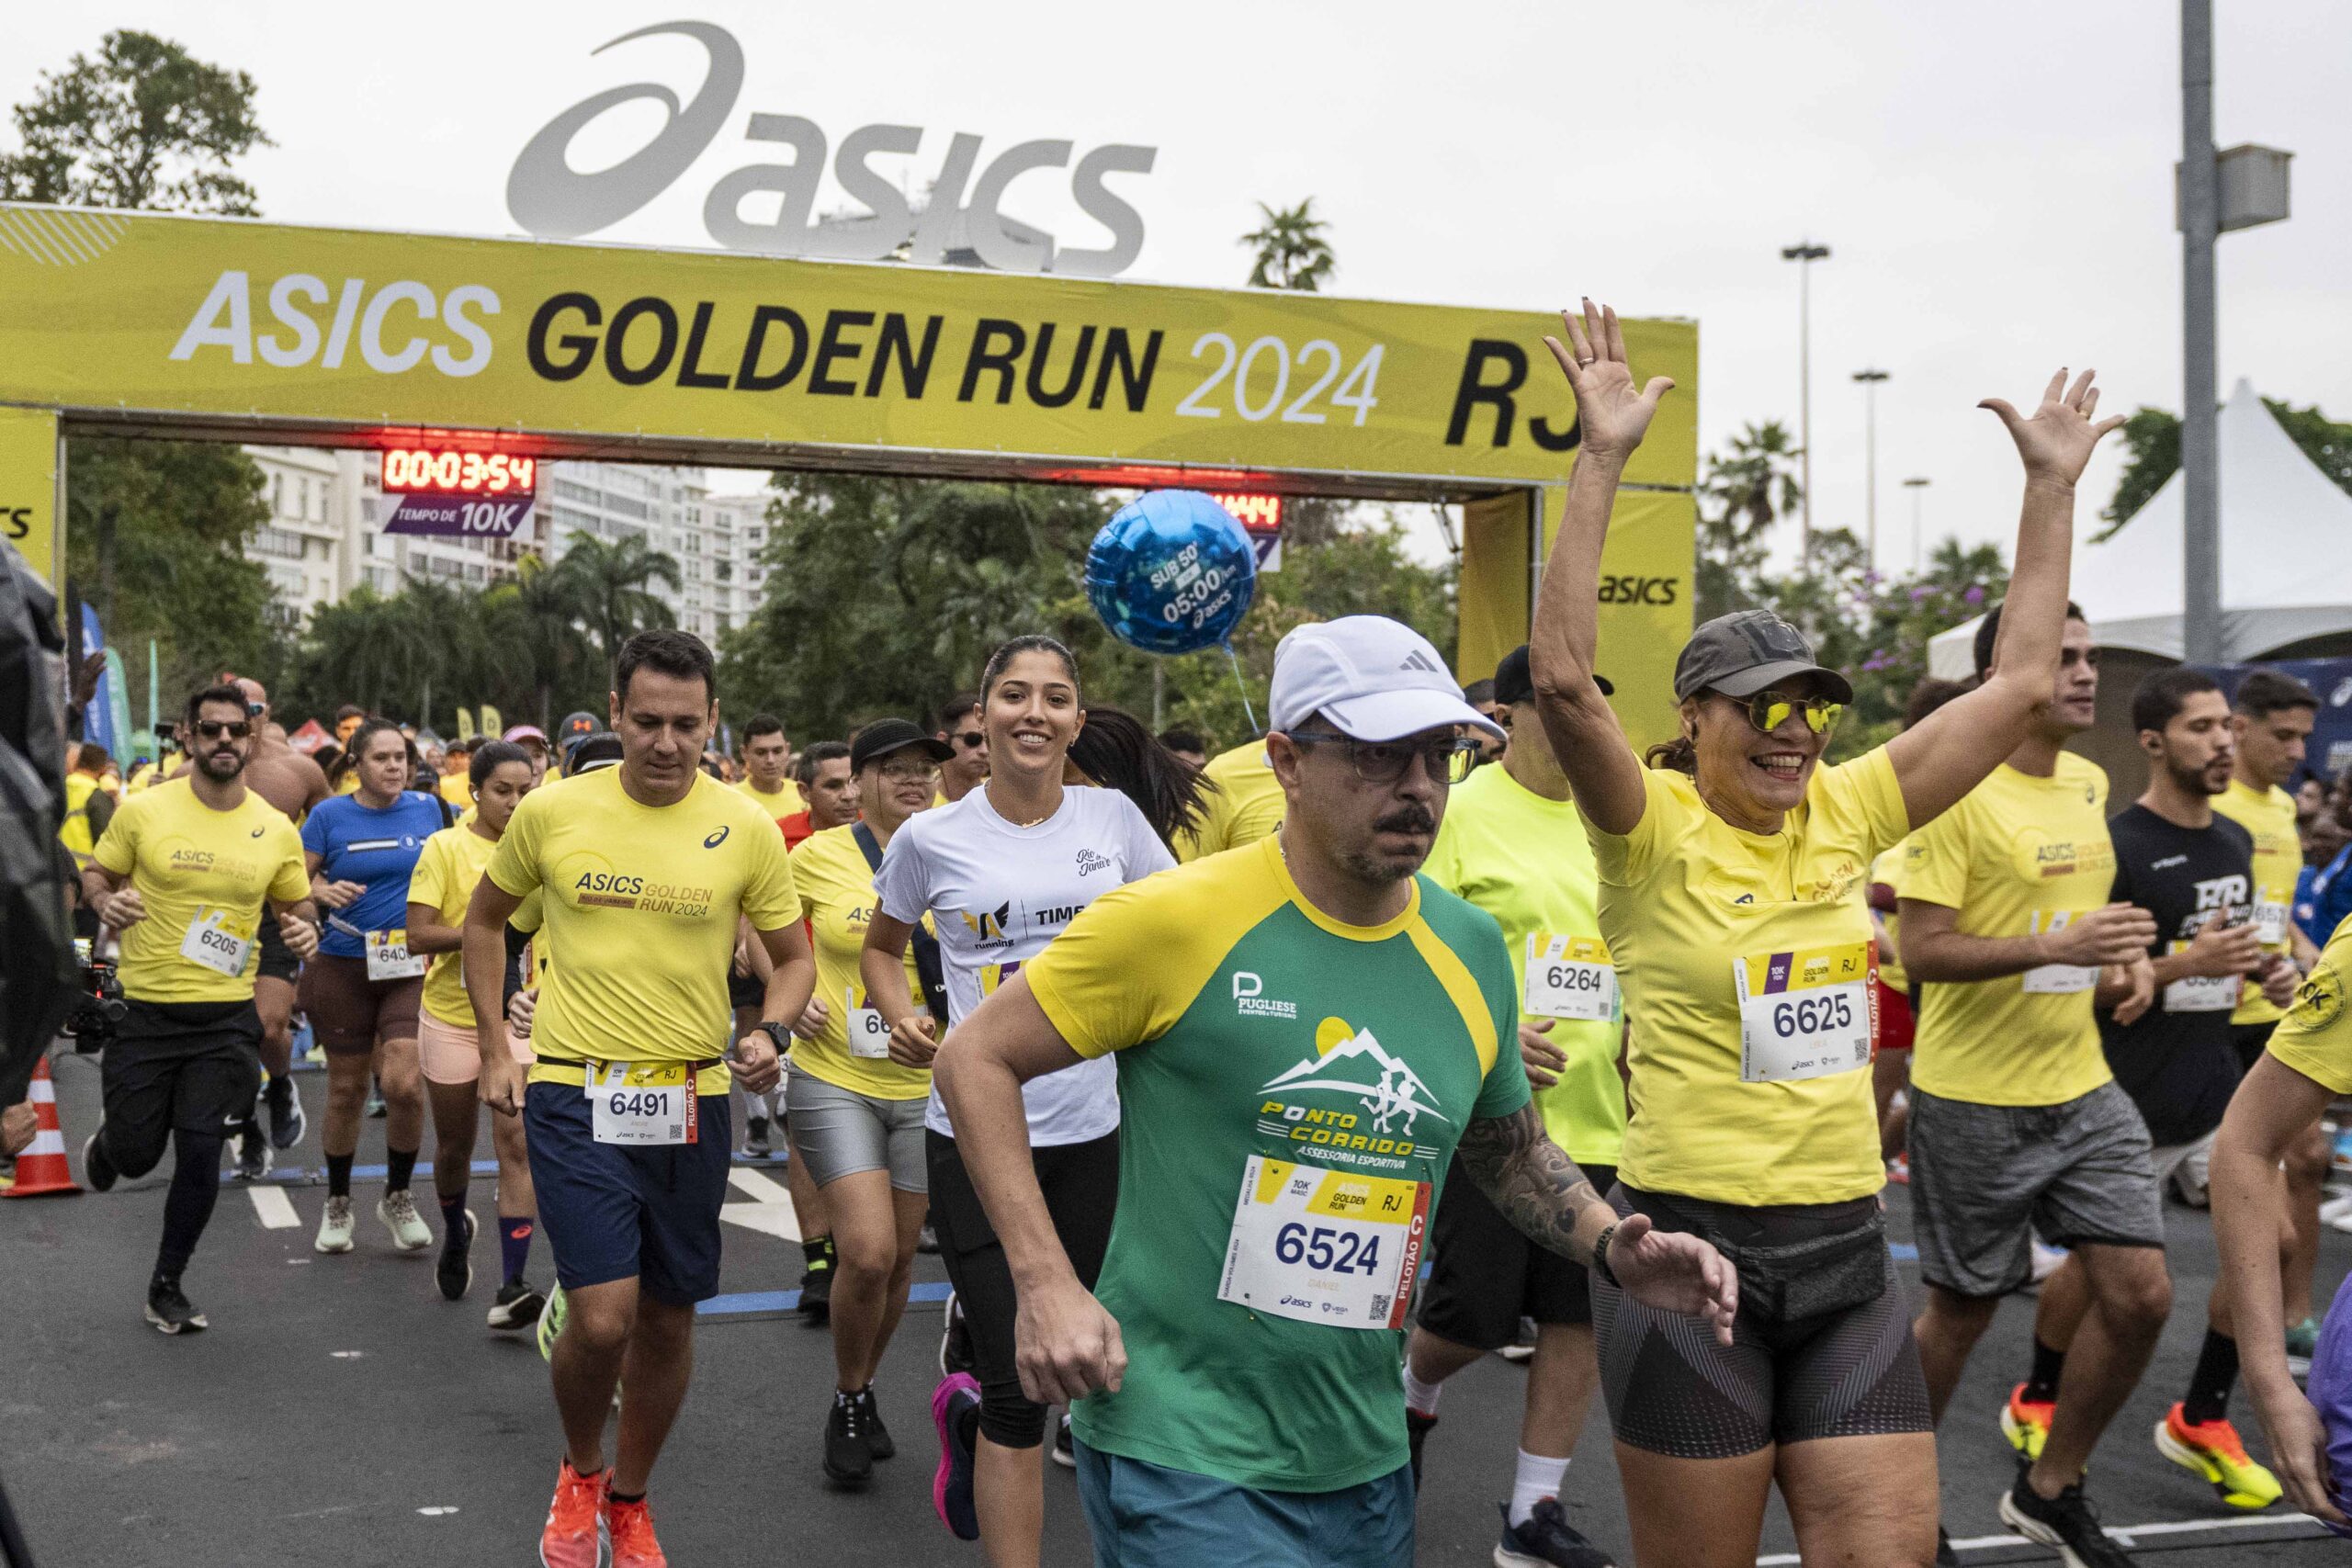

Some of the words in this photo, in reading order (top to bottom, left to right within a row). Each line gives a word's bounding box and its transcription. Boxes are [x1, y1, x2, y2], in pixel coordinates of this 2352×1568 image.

[704, 111, 1158, 276] asics
[169, 270, 503, 378] ASICS
[527, 291, 944, 400] GOLDEN
[957, 318, 1164, 412] RUN
[1176, 332, 1385, 427] 2024
[385, 448, 534, 491] 00:03:54
[398, 507, 438, 522] TEMPO
[440, 509, 458, 523] DE
[461, 502, 520, 533] 10K
[1150, 559, 1180, 590] SUB
[1598, 574, 1679, 605] asics
[170, 850, 214, 864] ASICS
[1076, 848, 1096, 863] Rio
[2037, 842, 2076, 863] ASICS
[575, 872, 644, 895] ASICS
[645, 883, 714, 903] GOLDEN
[639, 897, 675, 914] RUN
[674, 903, 708, 917] 2024
[200, 930, 239, 956] 6205
[975, 938, 1015, 951] running
[379, 946, 413, 964] 640
[1770, 965, 1786, 976] 10K
[1804, 966, 1829, 977] GOLDEN
[1841, 958, 1858, 974] RJ
[1546, 965, 1601, 993] 6264
[1866, 968, 1878, 986] C
[1238, 998, 1297, 1013] PUGLIESE
[1773, 993, 1852, 1038] 6625
[1868, 988, 1880, 1039] PELOTÃO
[664, 1070, 677, 1080] RJ
[685, 1078, 695, 1091] C
[609, 1092, 669, 1117] 6491
[1260, 1100, 1358, 1130] PONTO
[1289, 1125, 1415, 1156] CORRIDO
[1296, 1145, 1356, 1165] ASSESSORIA
[1356, 1156, 1407, 1170] ESPORTIVA
[1293, 1179, 1312, 1190] 10K
[1329, 1201, 1347, 1211] RUN
[1332, 1192, 1367, 1206] GOLDEN
[1381, 1194, 1403, 1212] RJ
[1275, 1222, 1380, 1276] 6524
[1397, 1241, 1419, 1300] PELOTÃO
[1410, 1214, 1423, 1235] C
[1291, 1296, 1314, 1309] asics
